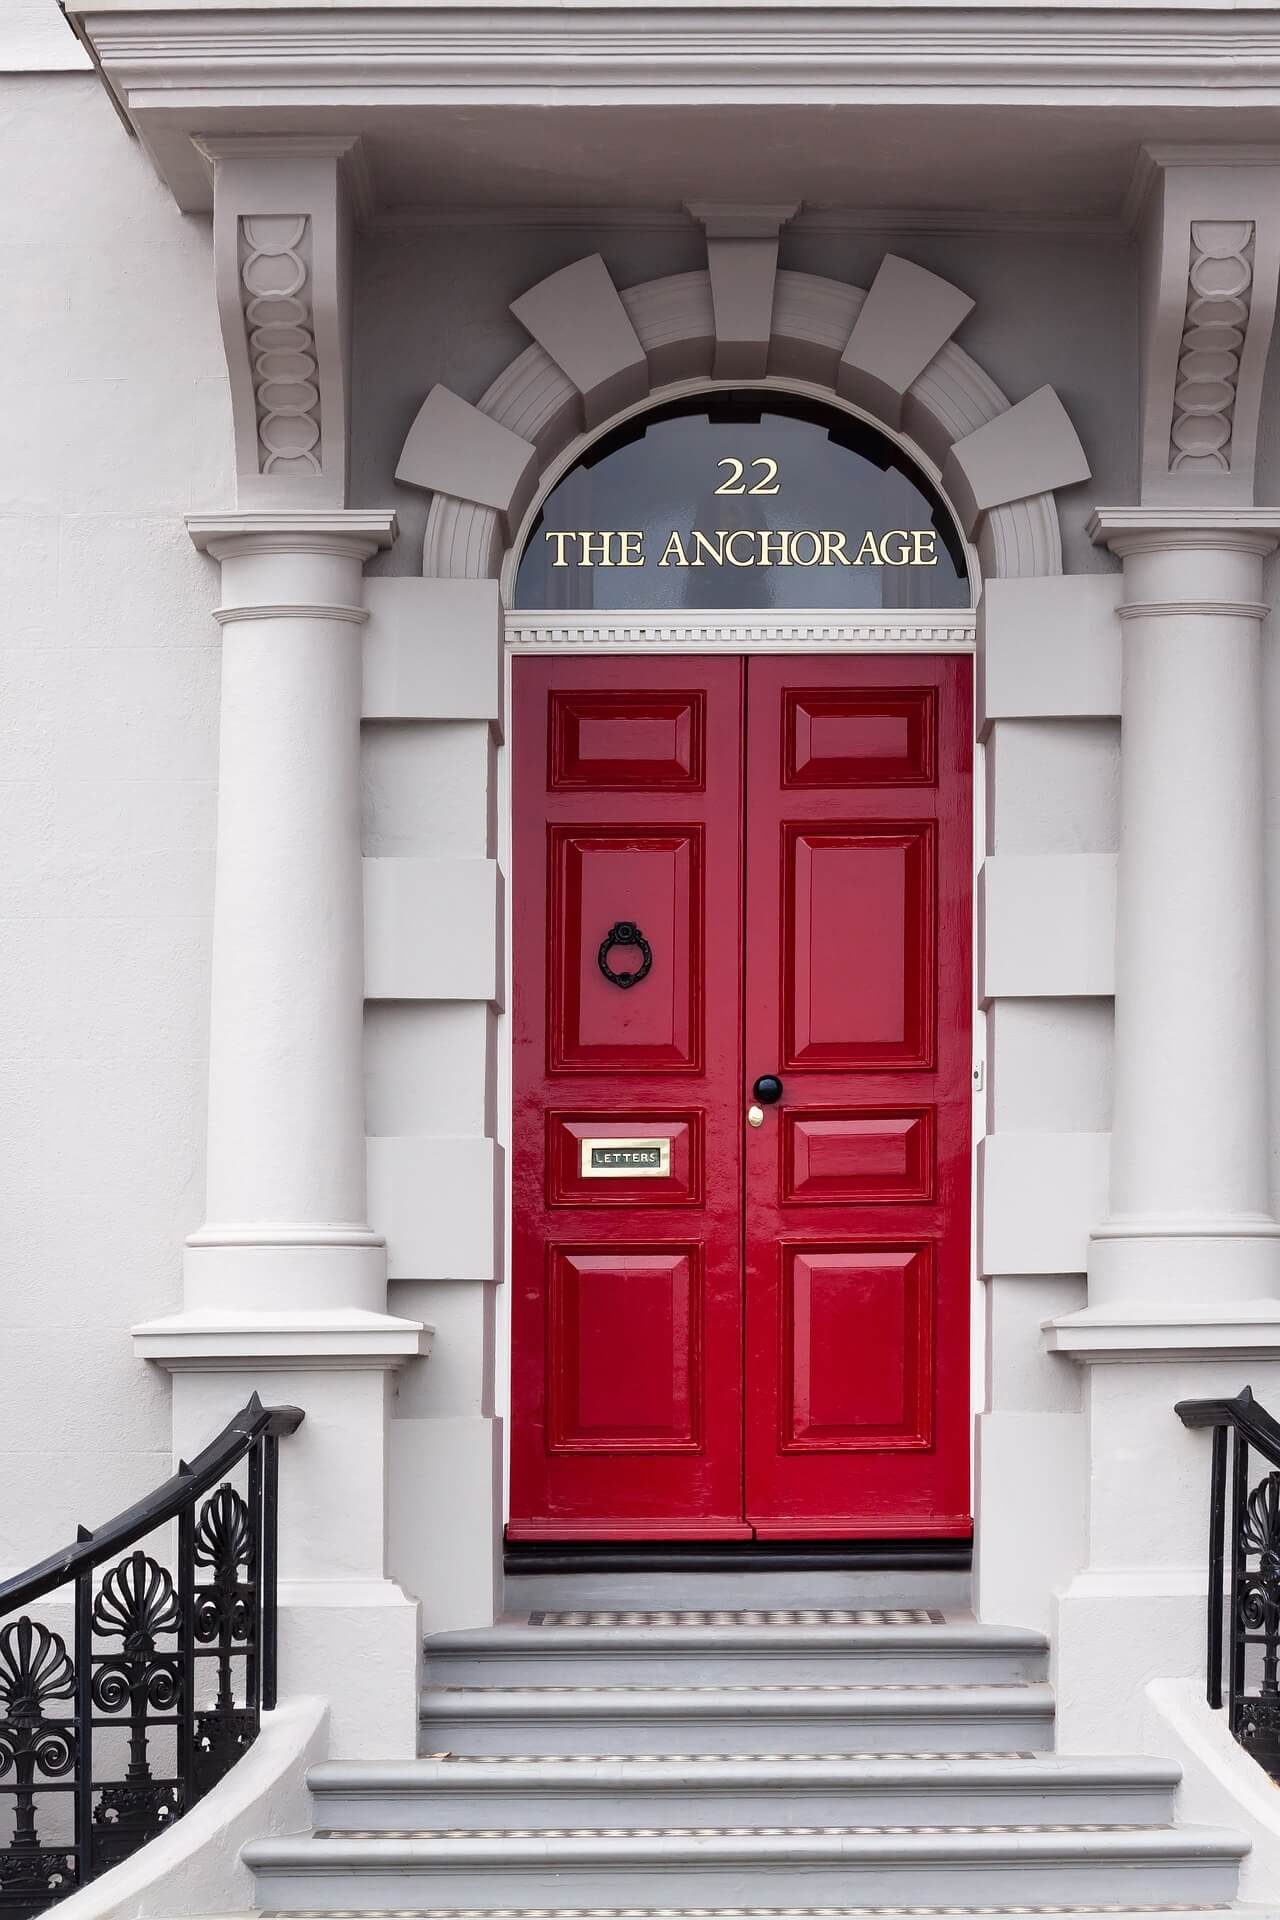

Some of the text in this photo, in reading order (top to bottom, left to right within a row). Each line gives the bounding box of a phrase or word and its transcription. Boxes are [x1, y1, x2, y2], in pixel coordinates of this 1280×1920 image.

[713, 457, 781, 495] 22
[545, 530, 938, 567] THE ANCHORAGE
[595, 1153, 656, 1163] LETTERS
